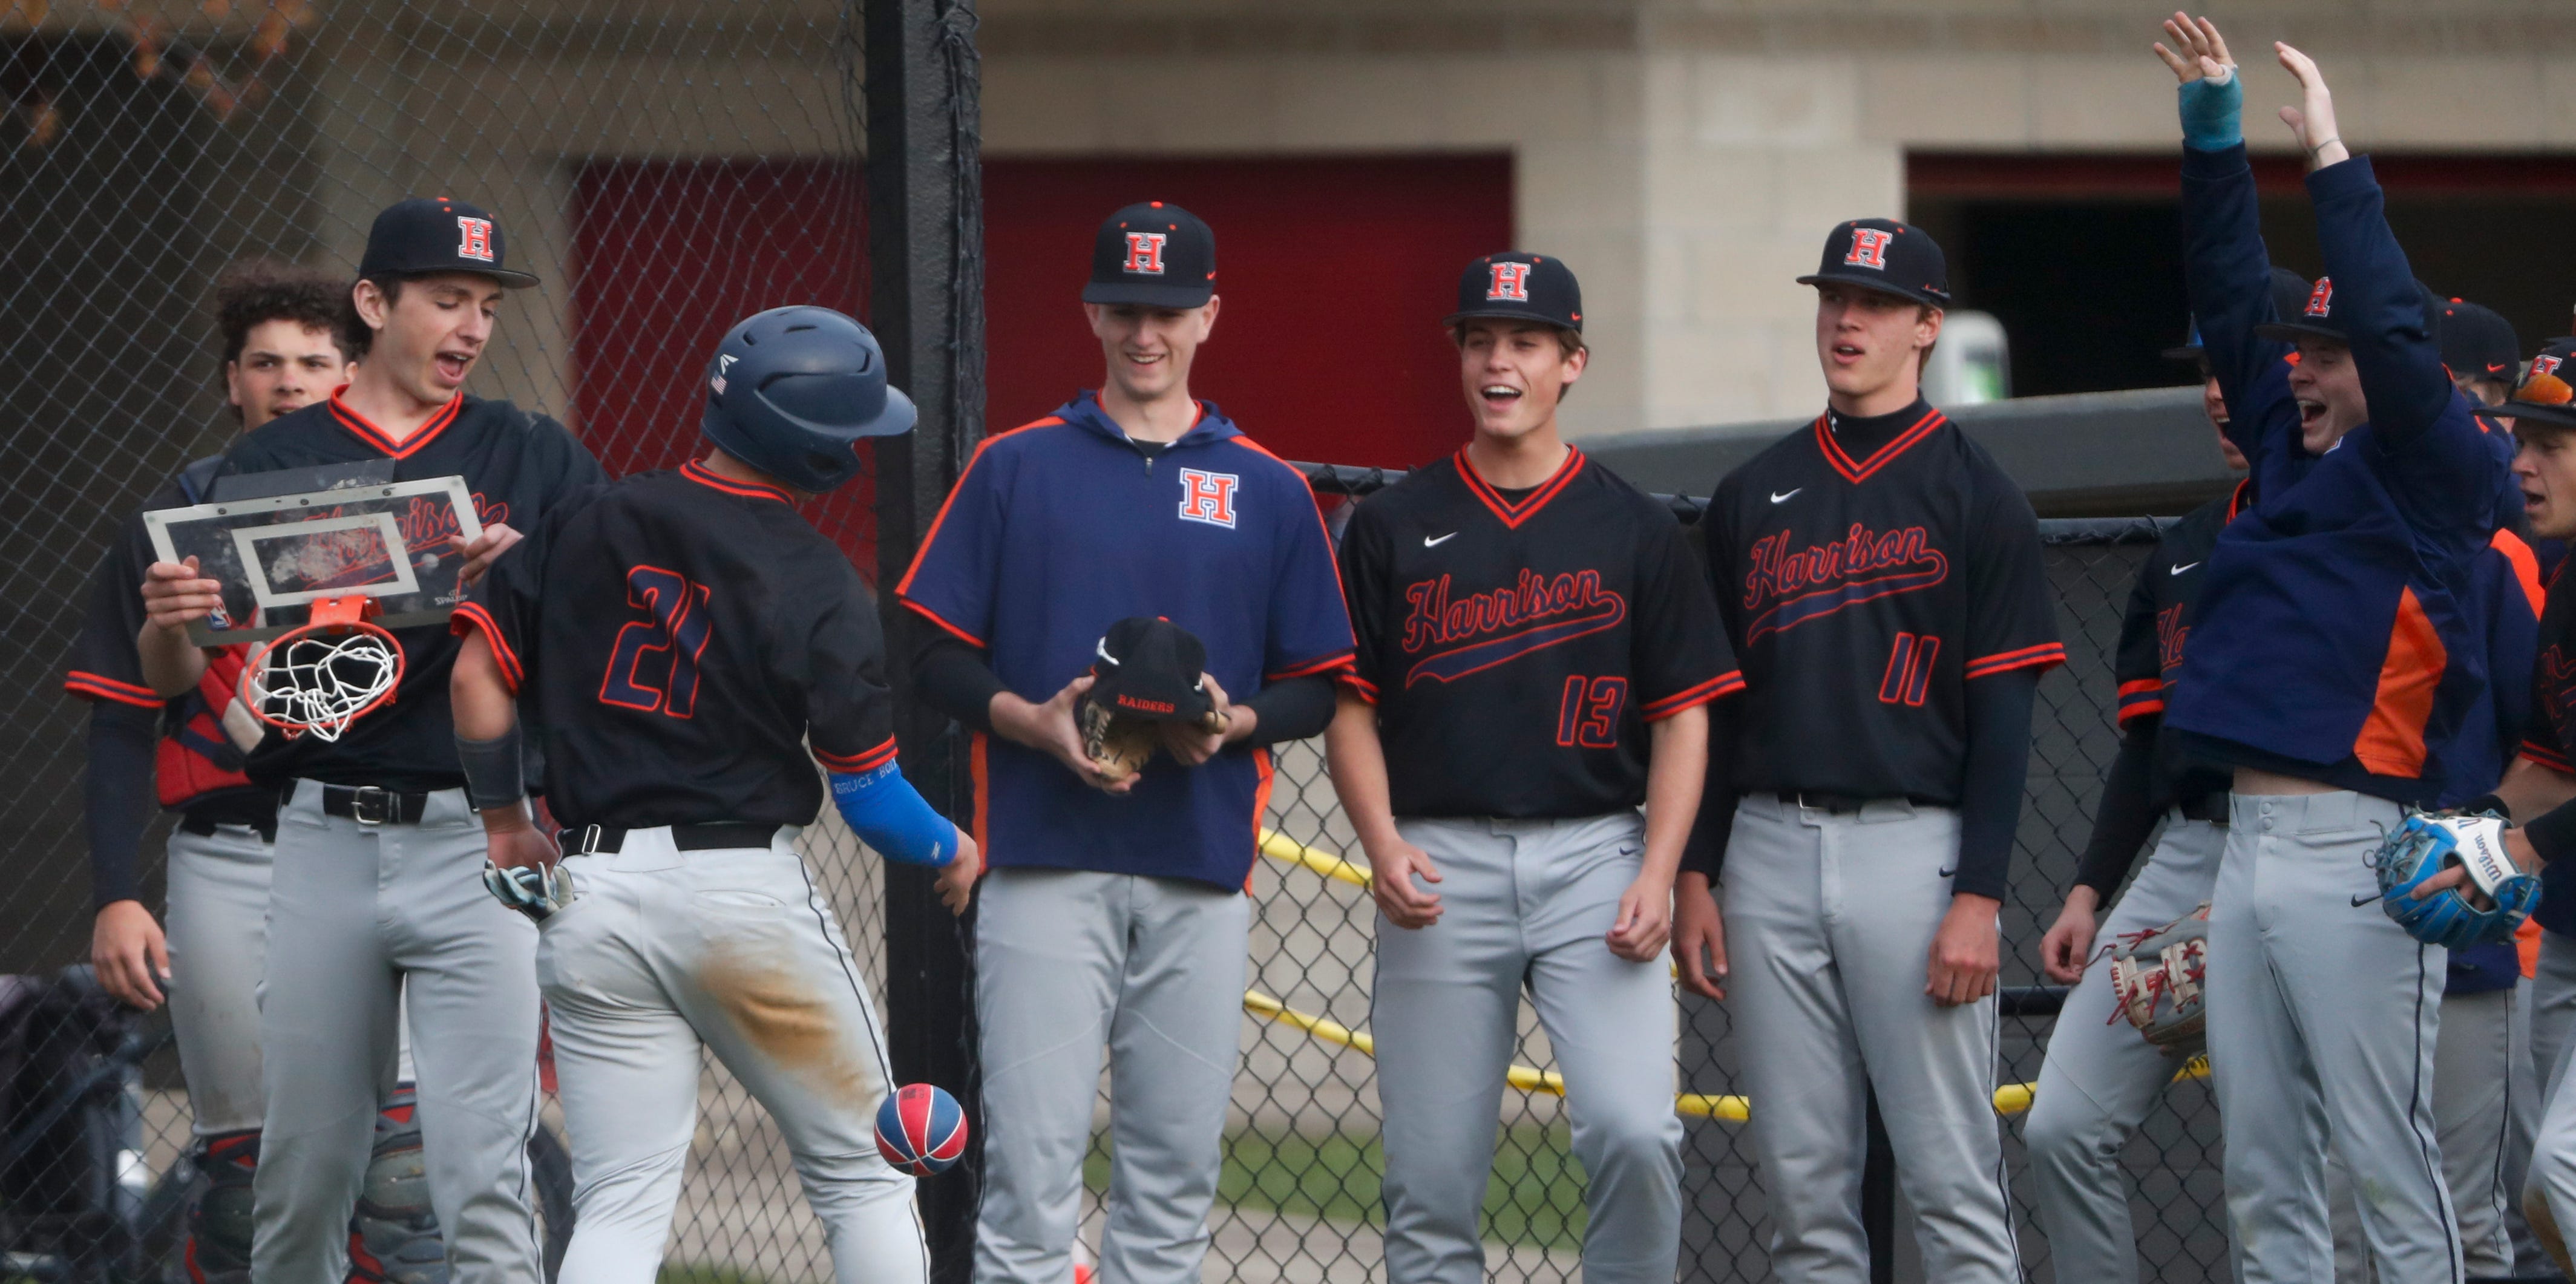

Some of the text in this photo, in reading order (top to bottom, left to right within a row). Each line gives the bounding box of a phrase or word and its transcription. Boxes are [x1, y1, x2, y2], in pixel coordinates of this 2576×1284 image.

[457, 215, 494, 262] H
[1123, 232, 1166, 275] H
[1844, 228, 1892, 270] H
[1486, 261, 1530, 303] H
[1179, 467, 1239, 529] H
[1745, 523, 1948, 608] Harrison
[1402, 568, 1625, 653] Harrison
[598, 563, 710, 719] 21
[1879, 632, 1940, 706] 11
[1117, 694, 1175, 713] RAIDERS
[1556, 675, 1627, 748] 13
[834, 773, 874, 794] BRUCE
[2474, 834, 2502, 882] Wilson
